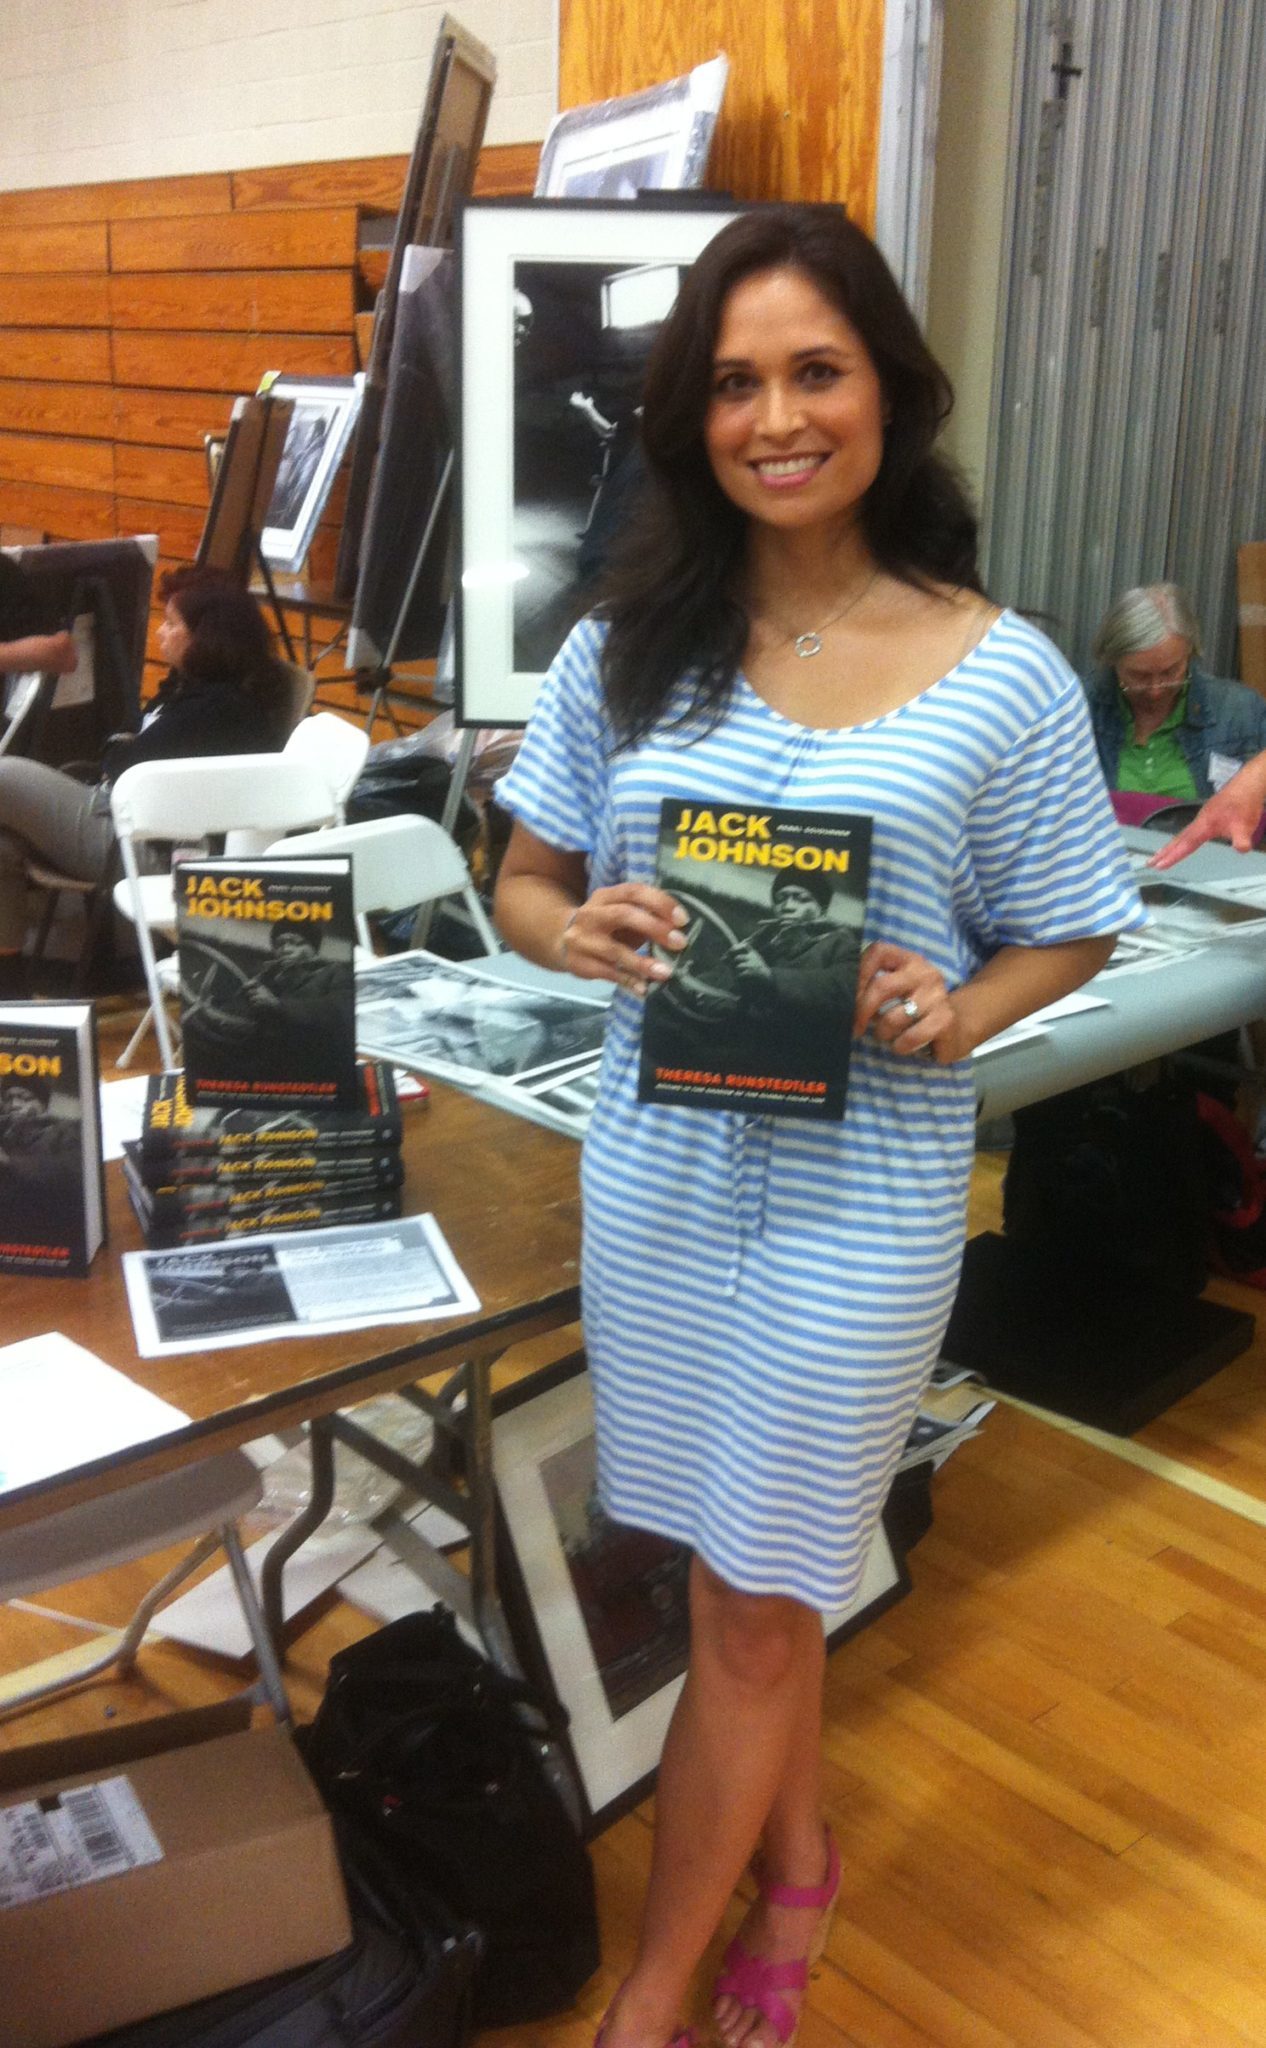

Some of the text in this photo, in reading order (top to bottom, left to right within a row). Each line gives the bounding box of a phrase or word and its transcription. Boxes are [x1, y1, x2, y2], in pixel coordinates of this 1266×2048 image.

[676, 808, 773, 839] JACK
[673, 835, 850, 874] JOHNSON
[185, 874, 265, 899] JACK
[186, 896, 333, 922] JOHNSON
